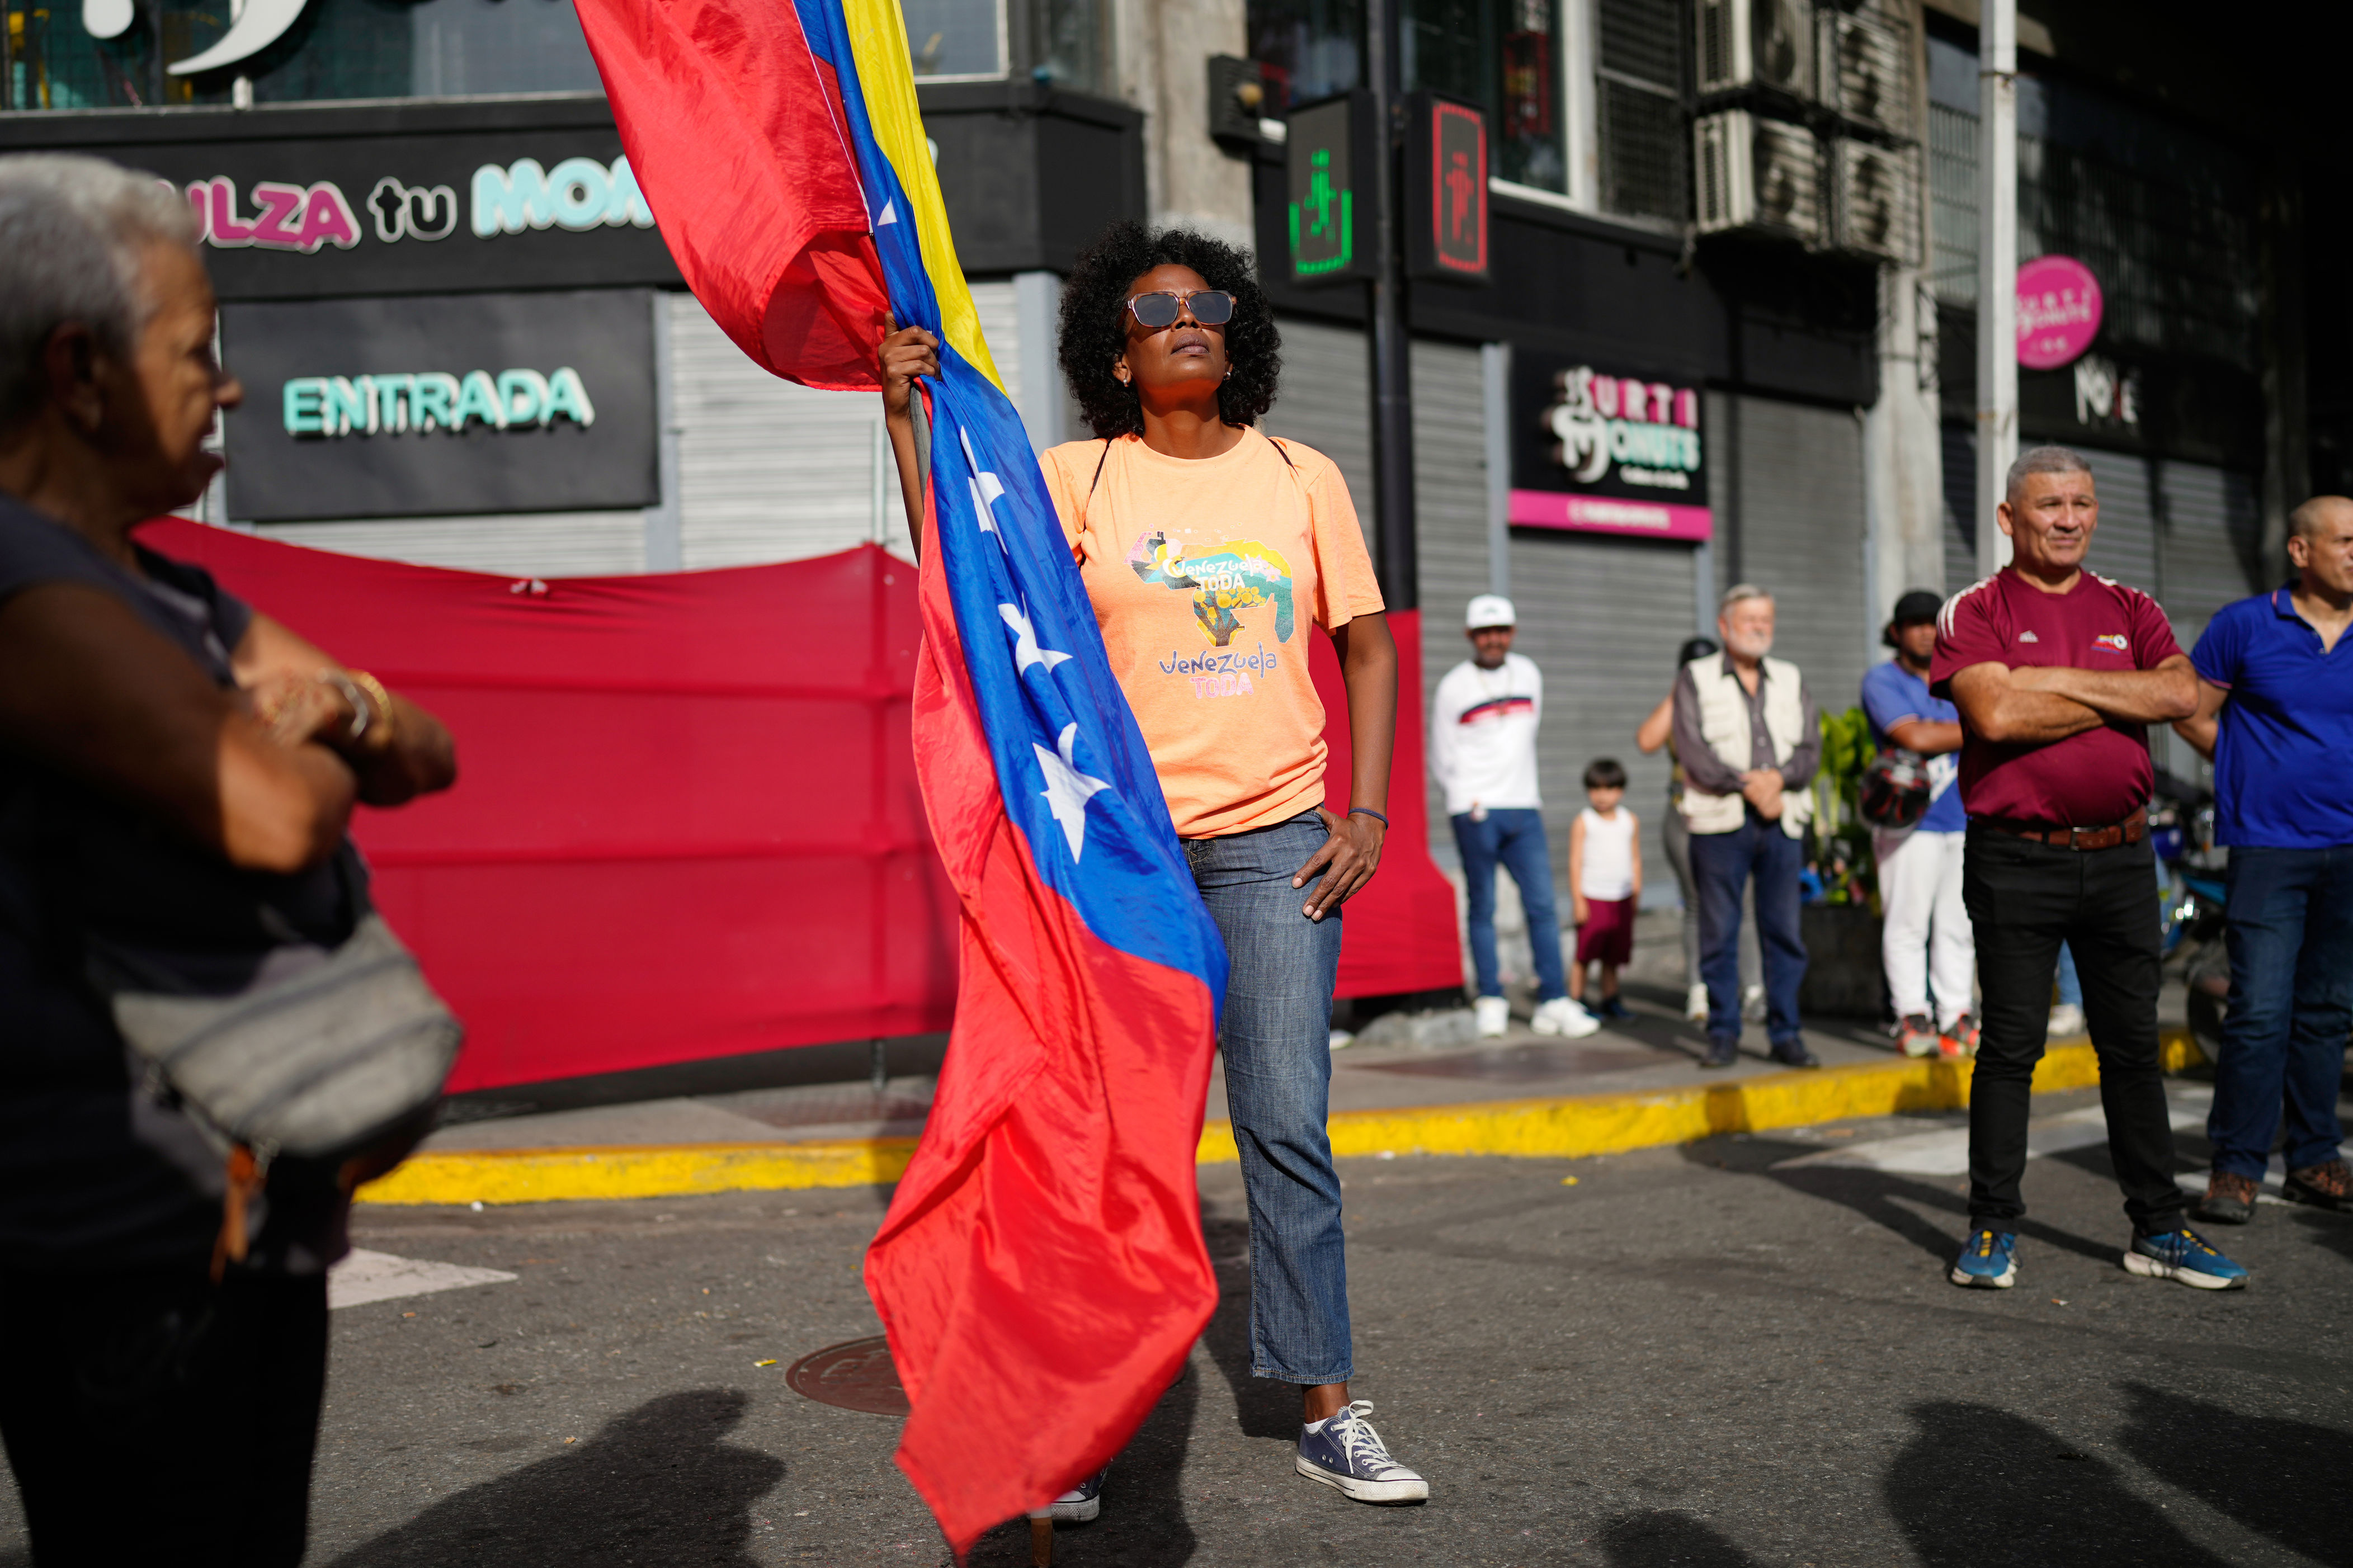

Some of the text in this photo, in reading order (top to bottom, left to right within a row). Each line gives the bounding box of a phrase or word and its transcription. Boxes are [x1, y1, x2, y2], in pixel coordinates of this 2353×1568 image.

[366, 176, 458, 243] tu
[282, 366, 596, 437] ENTRADA
[1171, 553, 1263, 577] Venezuela
[1195, 573, 1246, 592] TODA
[1158, 641, 1277, 679] Venezuela
[1189, 672, 1254, 699] TODA
